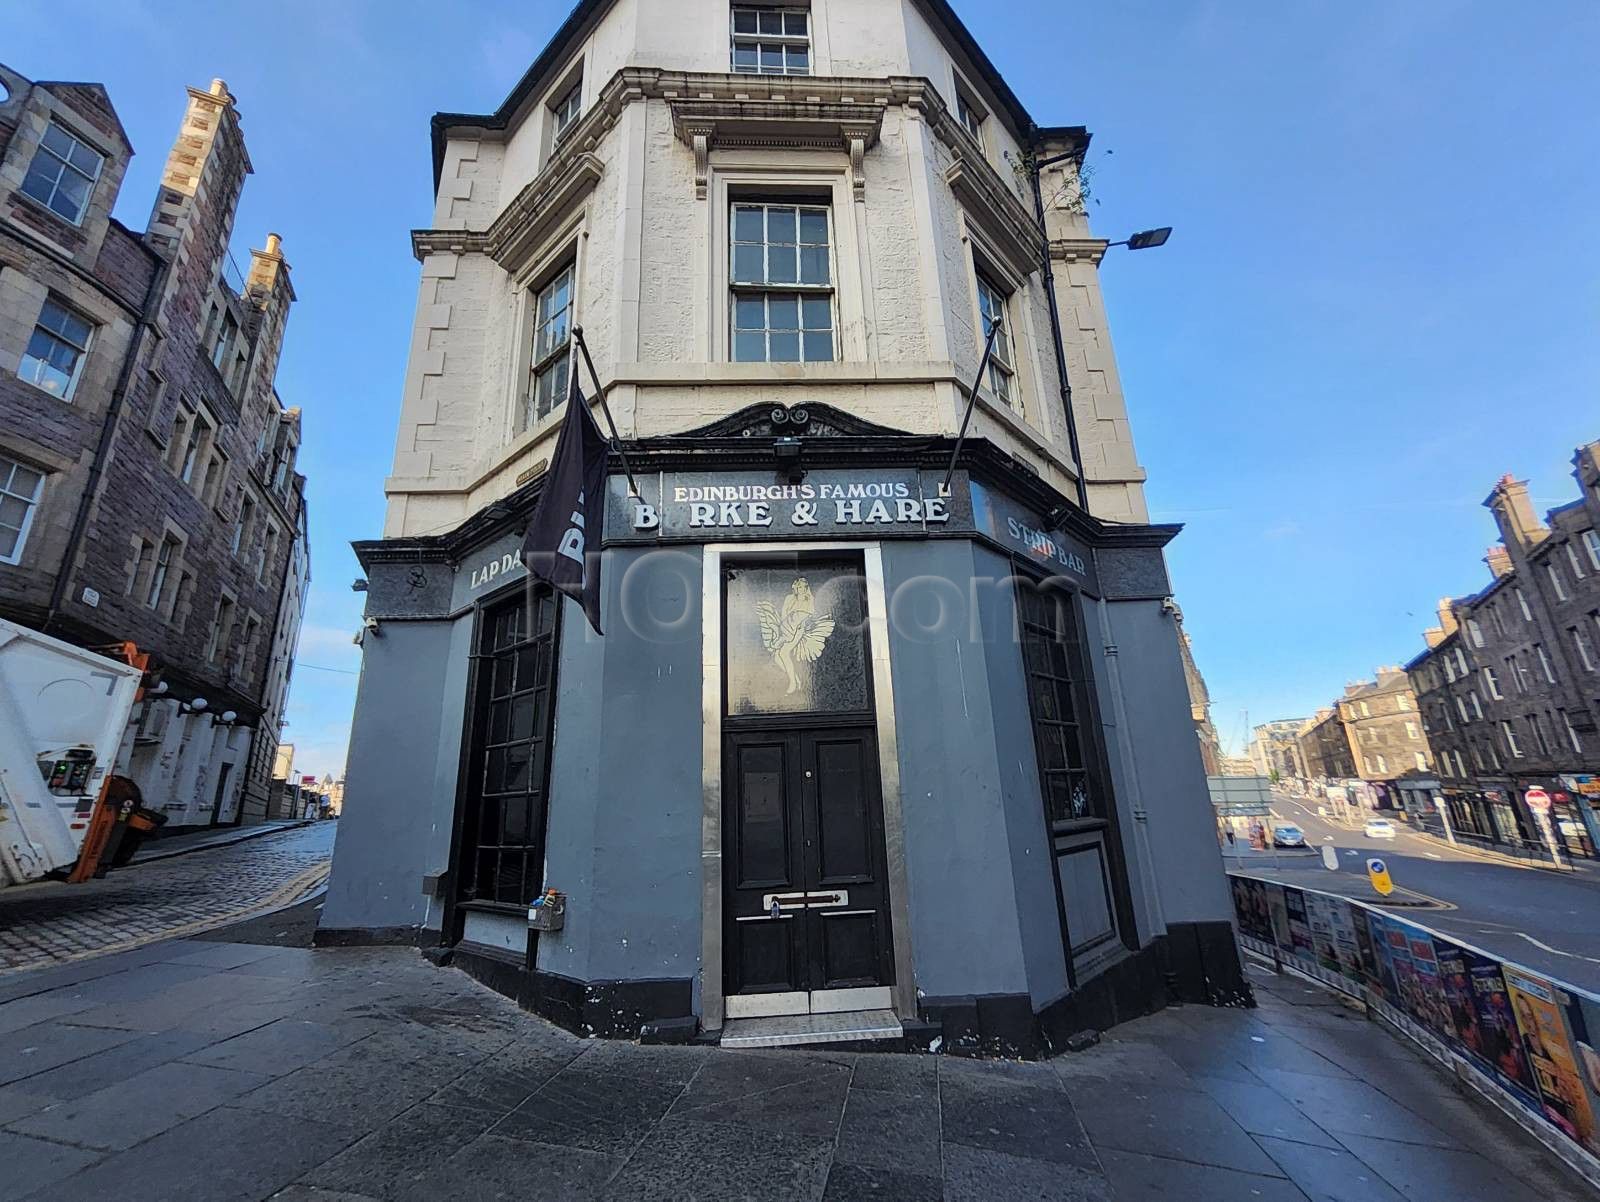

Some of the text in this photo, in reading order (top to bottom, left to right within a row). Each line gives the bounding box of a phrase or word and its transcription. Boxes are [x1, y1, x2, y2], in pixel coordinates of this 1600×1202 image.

[674, 482, 909, 502] EDINBURGH'S FAMOUS
[791, 500, 819, 526] &
[834, 497, 950, 524] HARE
[470, 560, 500, 590] LAP
[1057, 544, 1087, 577] BAR
